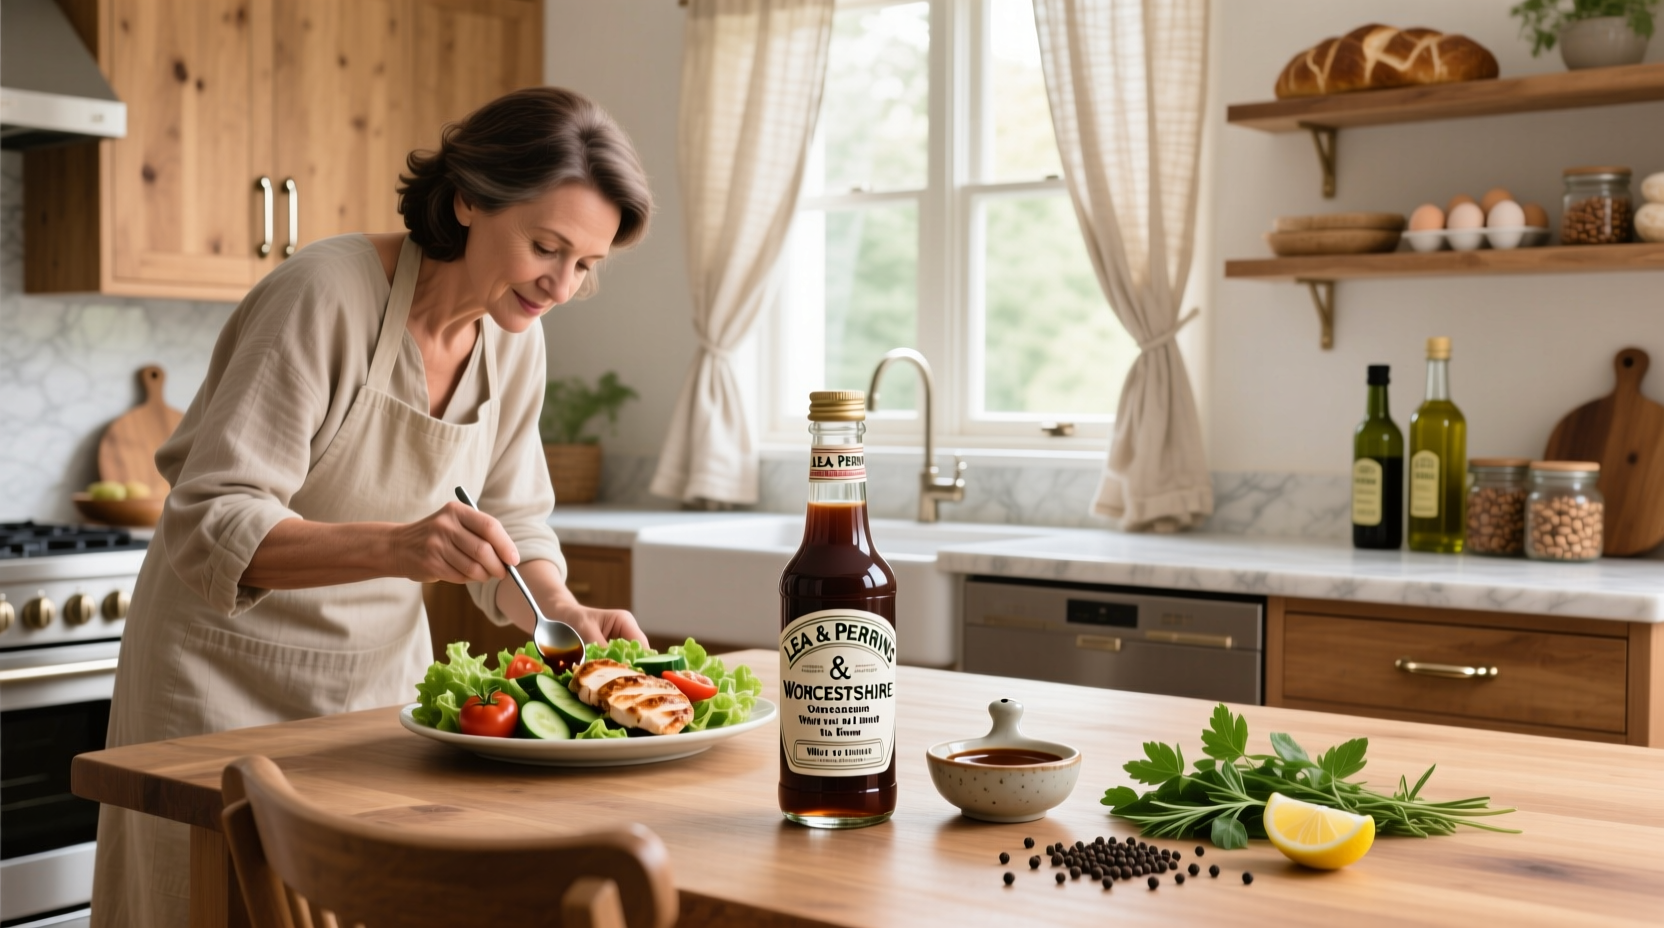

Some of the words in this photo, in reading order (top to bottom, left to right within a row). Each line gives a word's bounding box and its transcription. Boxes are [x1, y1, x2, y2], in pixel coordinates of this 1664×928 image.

[784, 632, 813, 663] LEA
[816, 625, 831, 643] &
[835, 622, 895, 663] PERRINS
[829, 655, 852, 680] &
